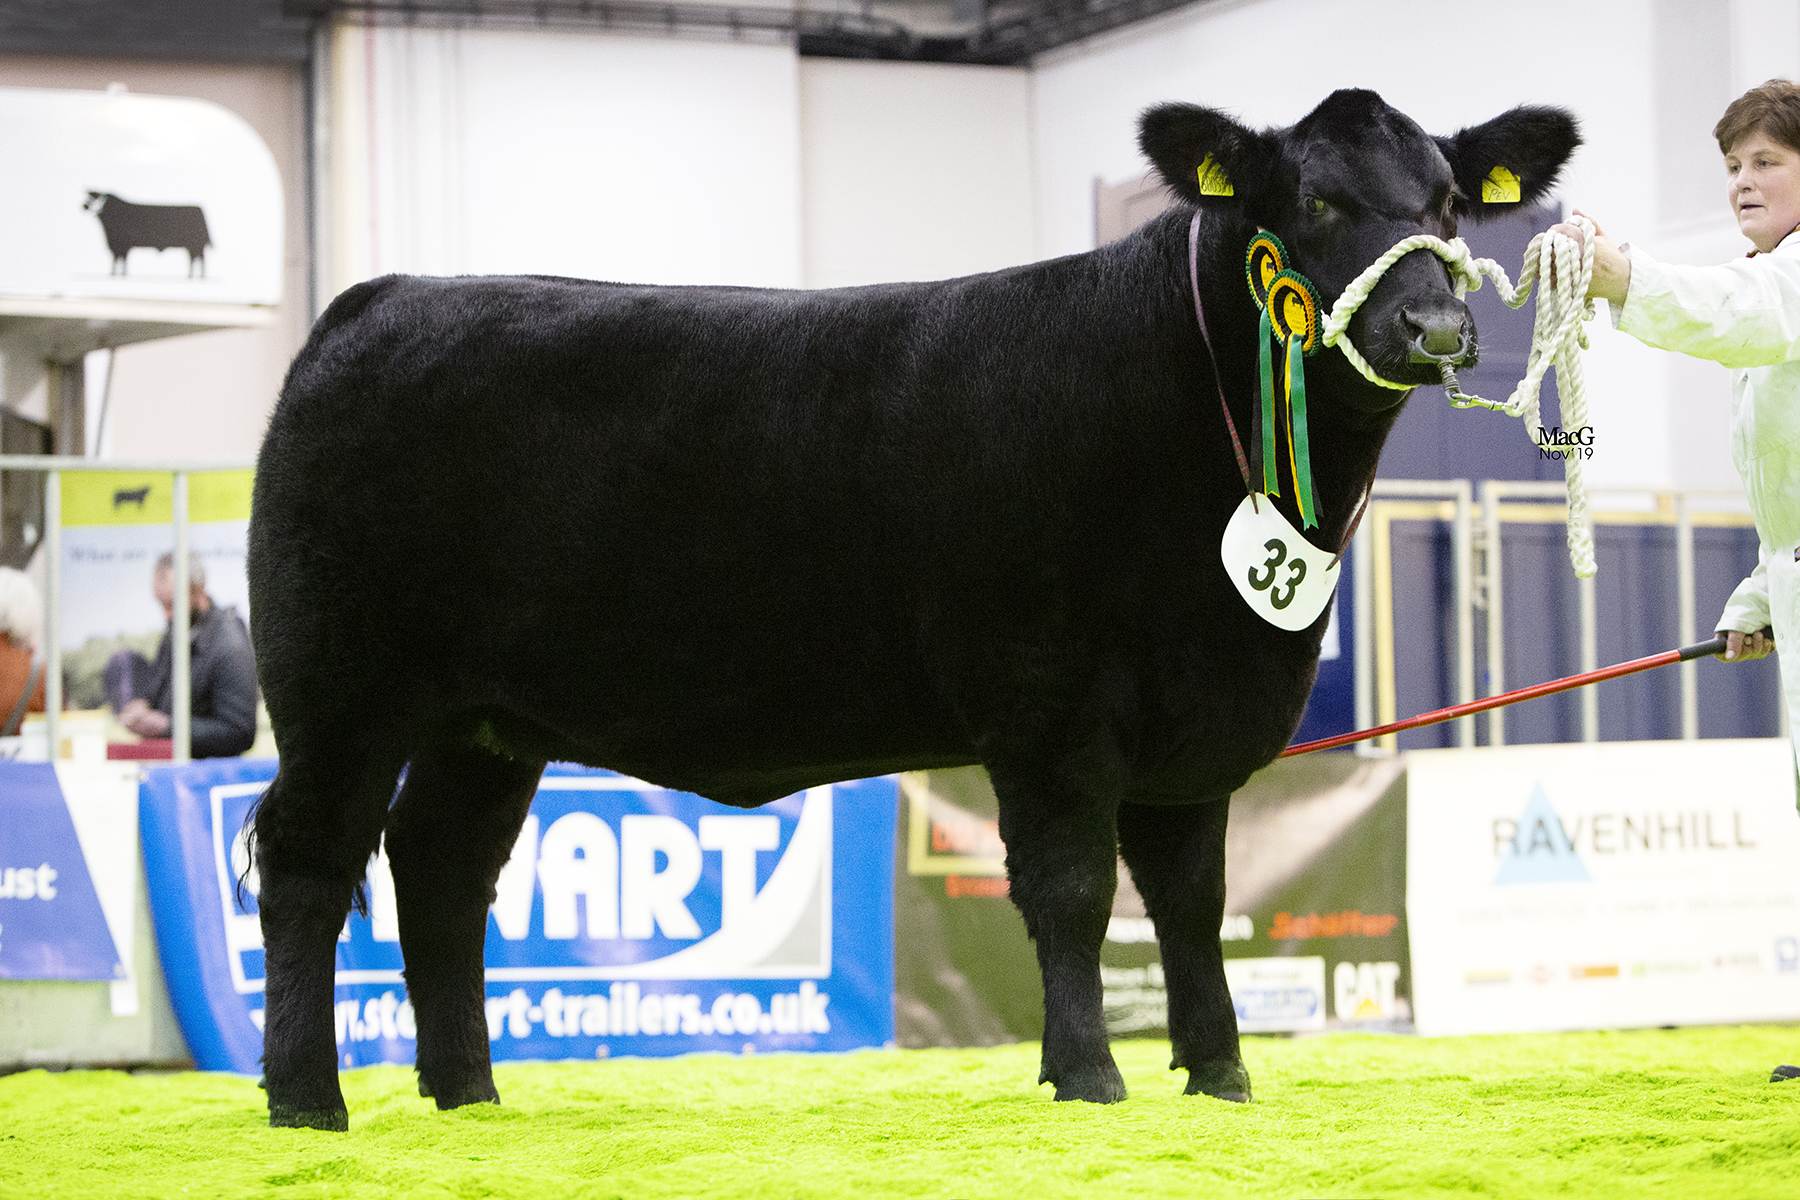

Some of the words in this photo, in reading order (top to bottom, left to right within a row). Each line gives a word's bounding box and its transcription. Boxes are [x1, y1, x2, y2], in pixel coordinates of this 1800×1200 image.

[1247, 537, 1308, 611] 33
[1491, 808, 1757, 858] RAVENHILL
[1333, 961, 1400, 1021] CAT
